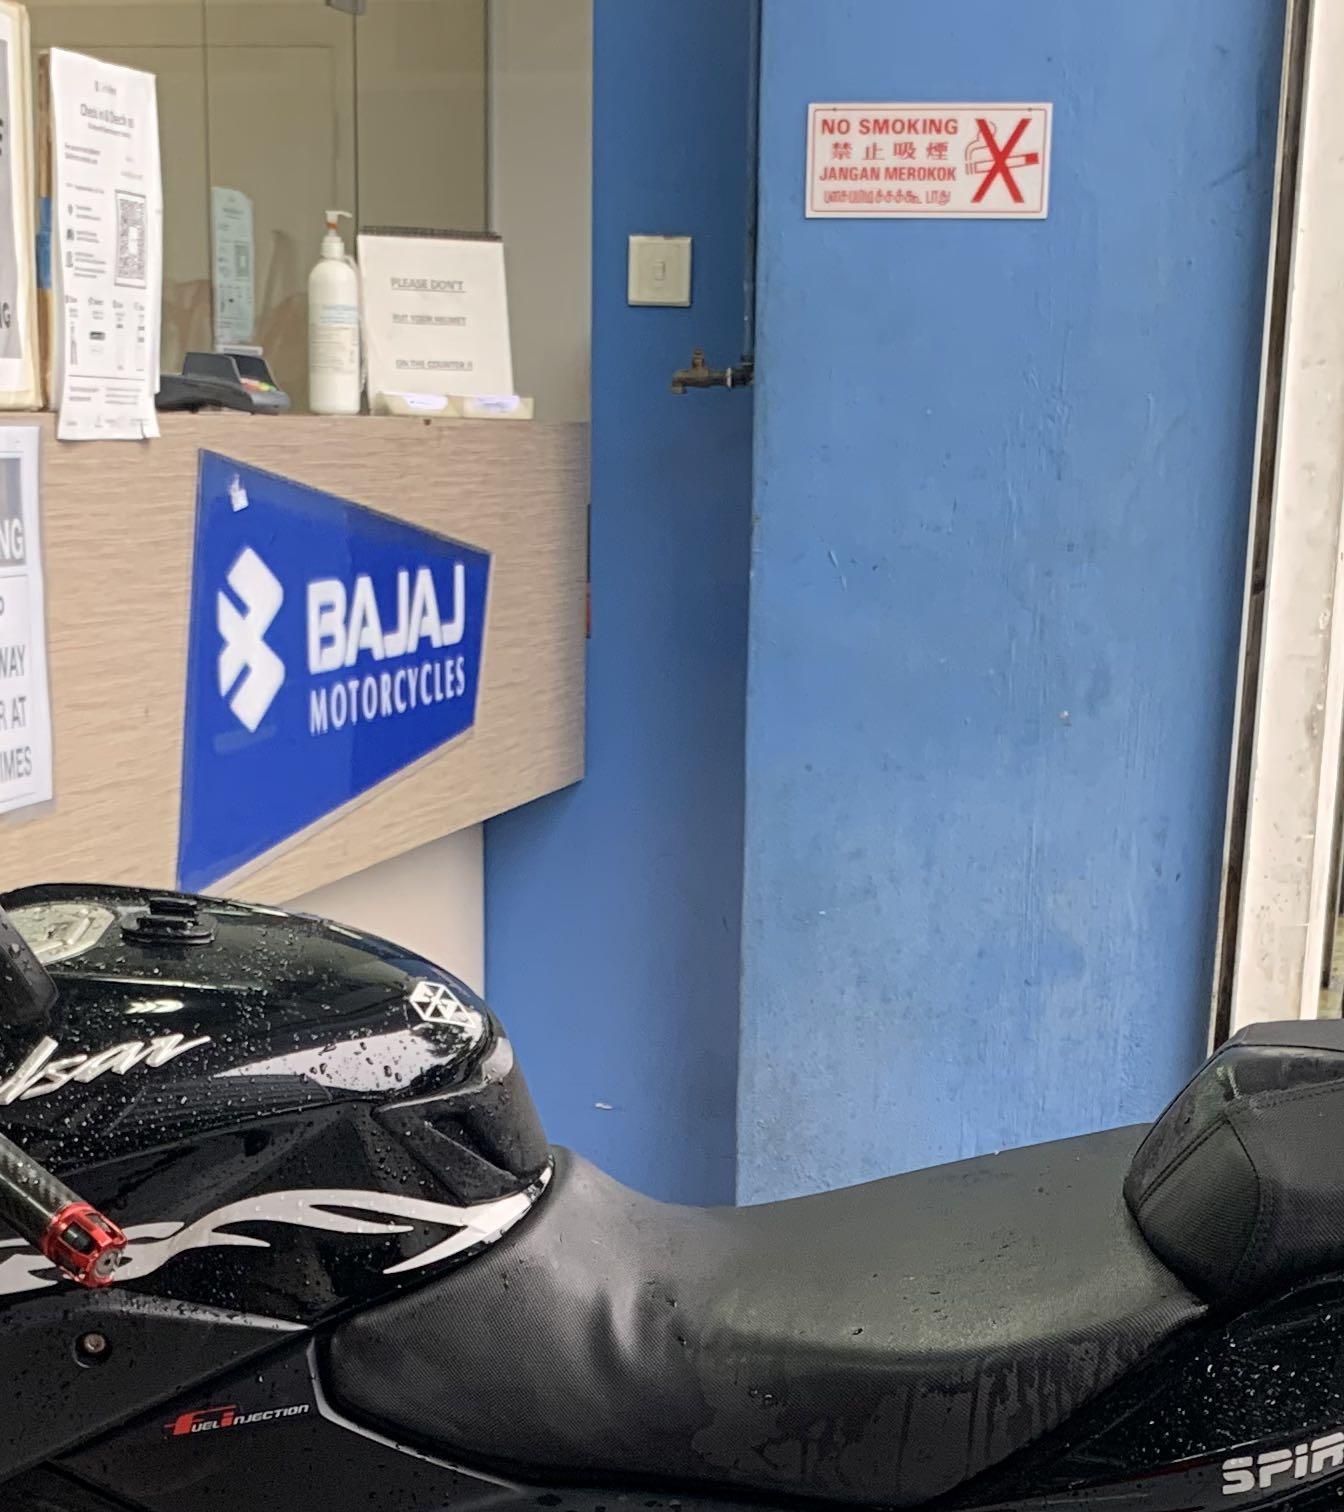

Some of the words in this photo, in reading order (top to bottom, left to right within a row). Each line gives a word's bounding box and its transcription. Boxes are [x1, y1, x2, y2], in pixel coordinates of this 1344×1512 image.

[821, 118, 851, 135] NO
[859, 118, 959, 135] SMOKING
[820, 167, 880, 181] JANGAN
[884, 166, 957, 181] MEROKOK
[307, 563, 466, 675] BAJAJ
[10, 696, 27, 728] AT
[310, 656, 466, 736] MOTORCYCLES
